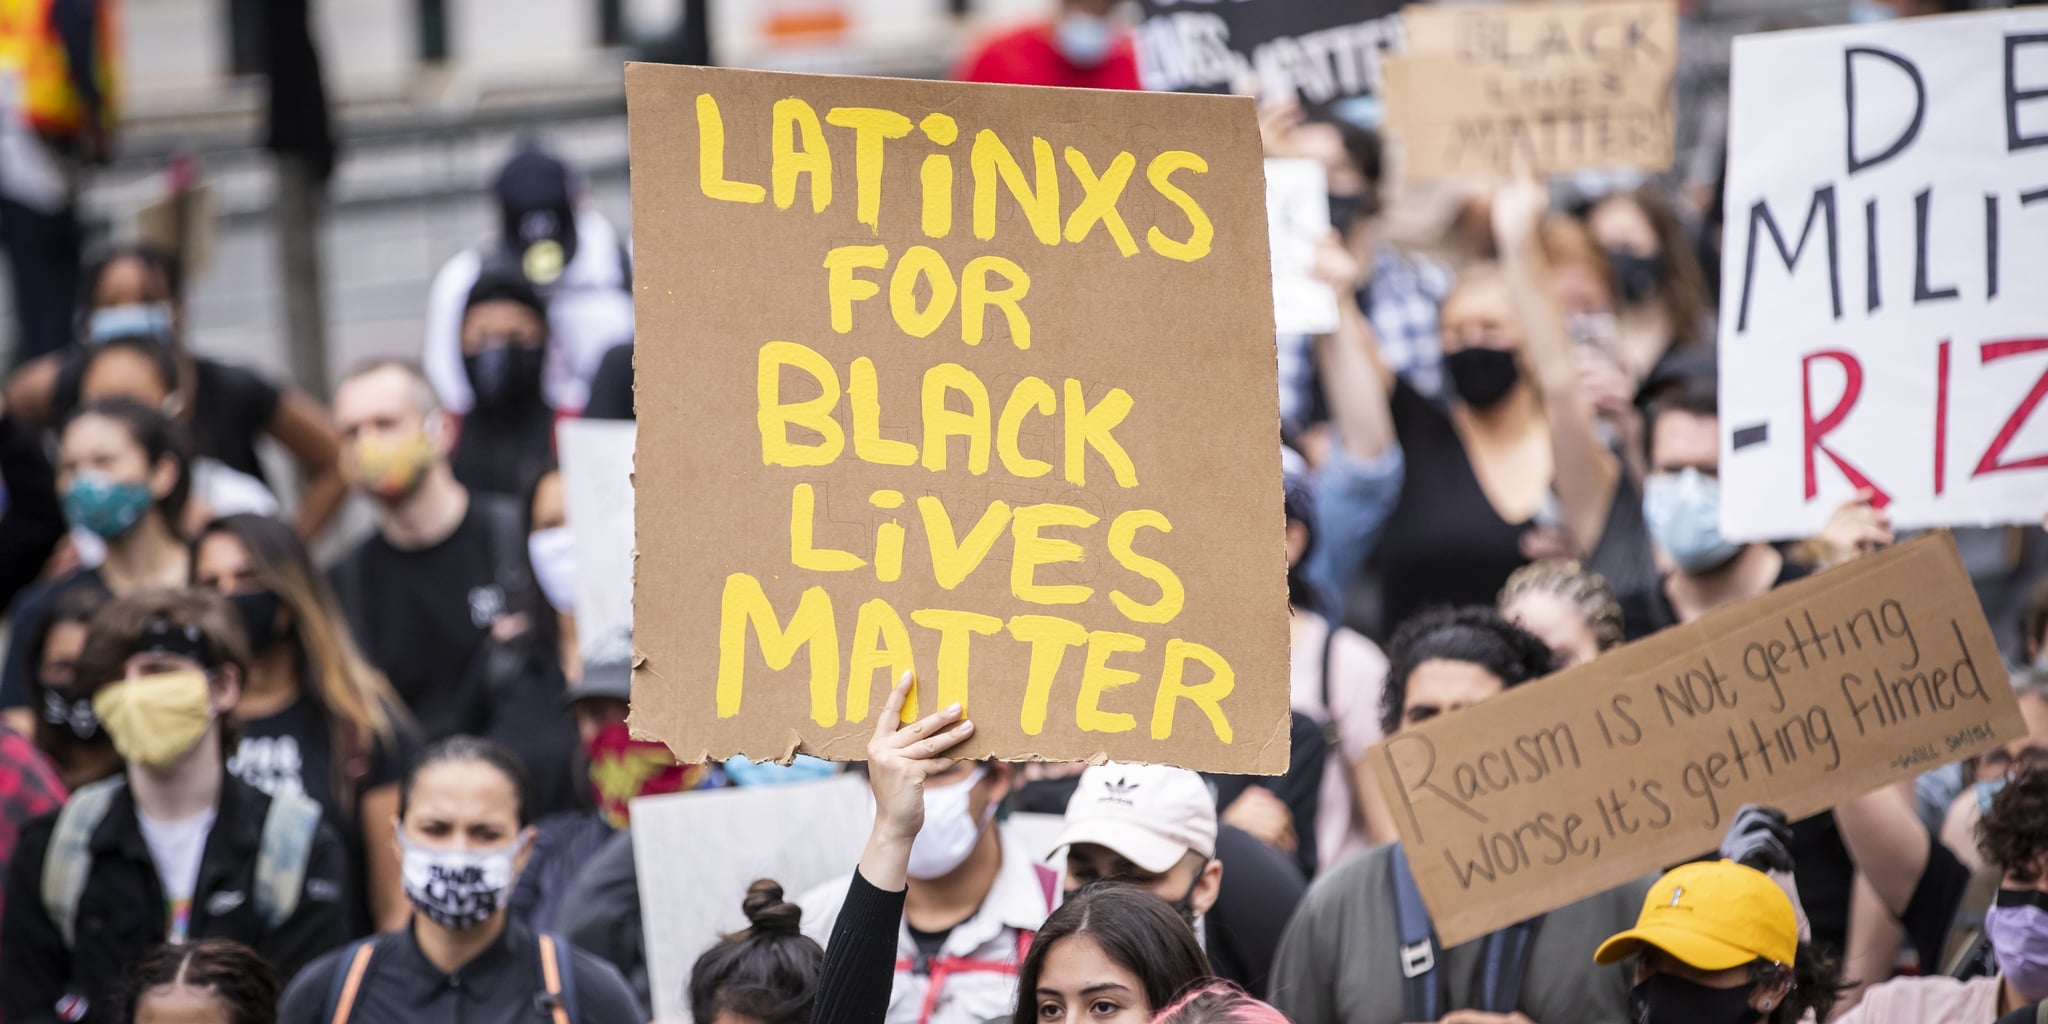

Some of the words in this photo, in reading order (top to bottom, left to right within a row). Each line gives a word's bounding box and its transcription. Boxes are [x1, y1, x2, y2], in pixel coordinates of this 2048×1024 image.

[823, 245, 1031, 350] FOR
[757, 341, 1139, 489] BLACK
[716, 573, 1235, 745] MATTER
[1383, 732, 1582, 844] Racism
[1743, 599, 1919, 714] getting
[1682, 704, 1840, 831] getting
[1840, 618, 1992, 737] filmed
